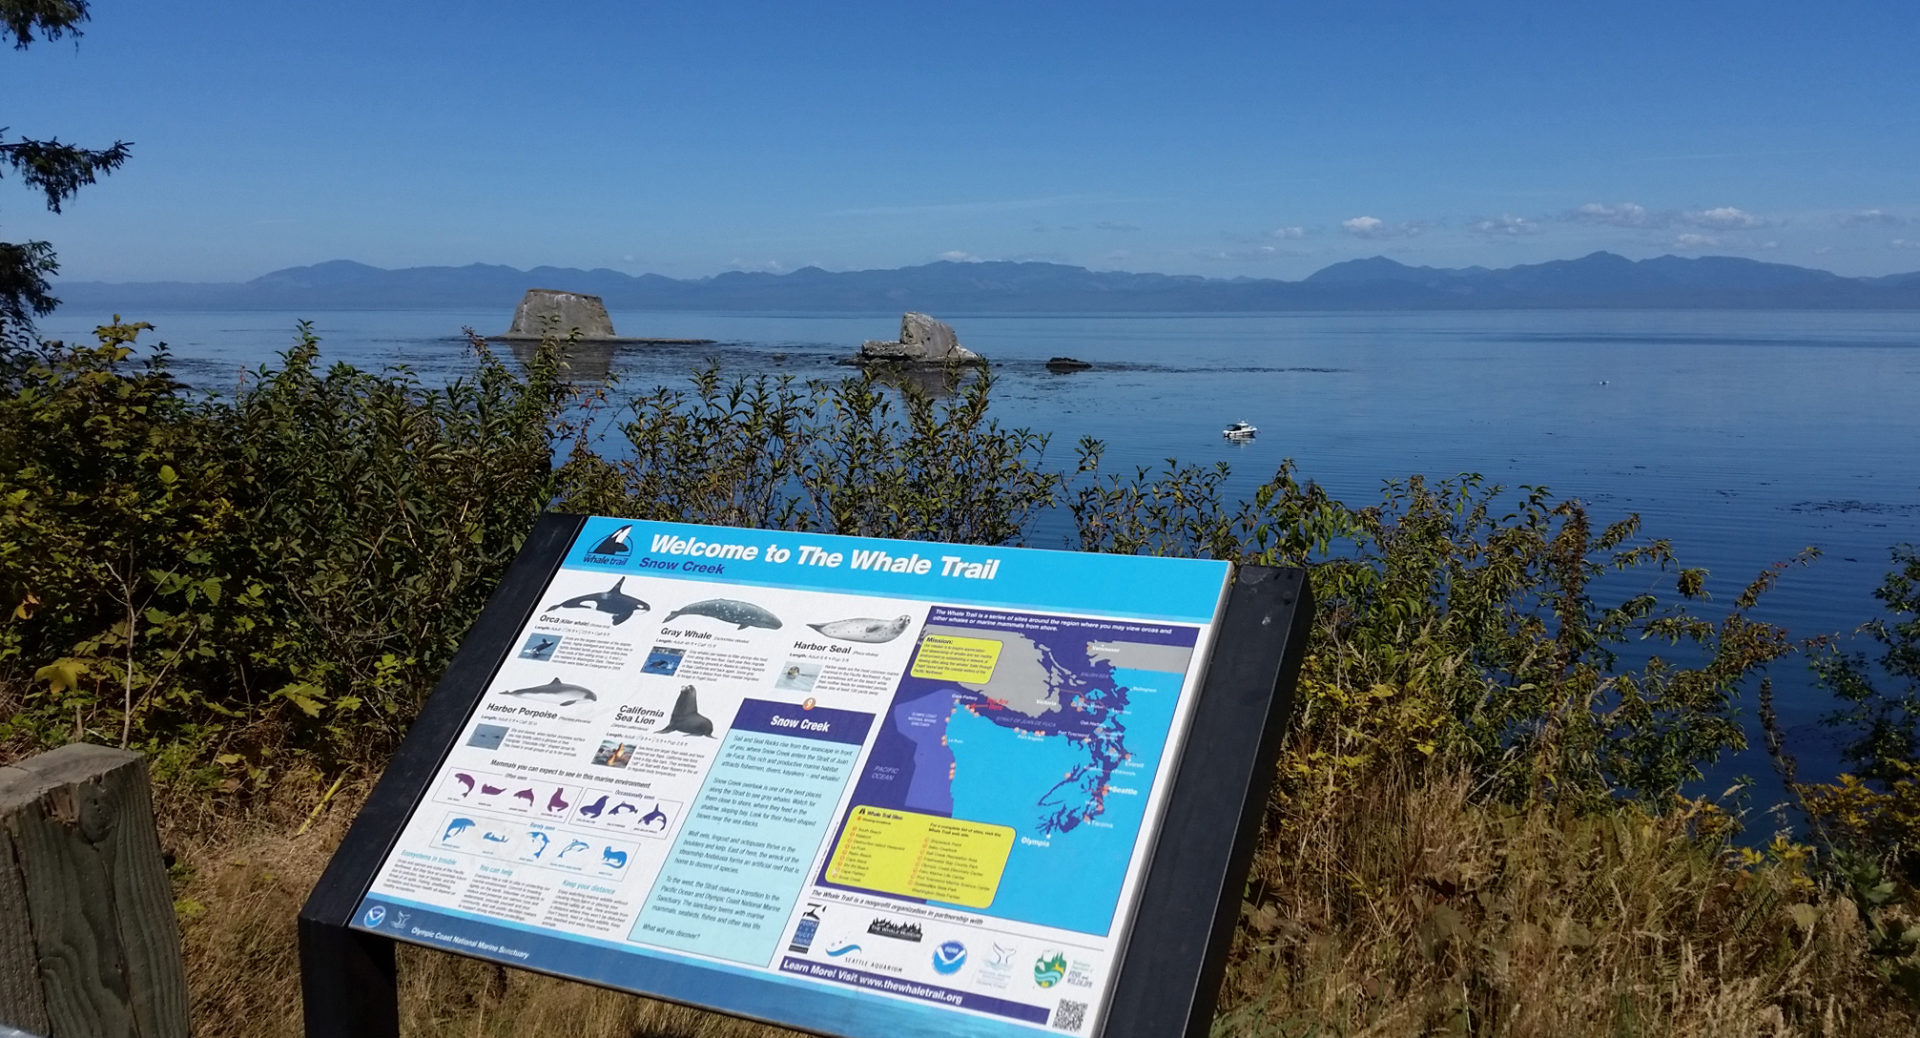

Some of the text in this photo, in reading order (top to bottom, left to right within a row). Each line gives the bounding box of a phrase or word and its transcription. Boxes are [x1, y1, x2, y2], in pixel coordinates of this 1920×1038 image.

[583, 552, 628, 565] whale trail
[650, 534, 999, 579] Welcome to The Whale Trail
[639, 557, 724, 573] Snow Creek
[539, 614, 560, 622] Orca
[660, 627, 712, 639] Gray Whale
[793, 641, 851, 653] Harbor Seal
[486, 703, 557, 719] Harbor Porpoise
[614, 712, 655, 724] Sea Lion
[619, 704, 664, 717] California
[770, 715, 829, 731] Snow Creek
[490, 759, 517, 768] Mammals
[614, 778, 651, 788] environment
[1111, 785, 1137, 795] Seattle
[1020, 836, 1050, 847] Olympia
[822, 891, 840, 899] Whale
[864, 899, 891, 908] nonprofit
[890, 904, 927, 915] organization
[933, 911, 968, 923] partnership
[411, 926, 529, 959] Olympic Coast National Marine Sanctuary
[844, 956, 902, 972] SEATTLE AQUARIUM
[783, 959, 808, 971] Learn
[810, 964, 836, 977] More!
[838, 970, 857, 981] Visit
[859, 976, 962, 1004] www.thewhaletrail.org
